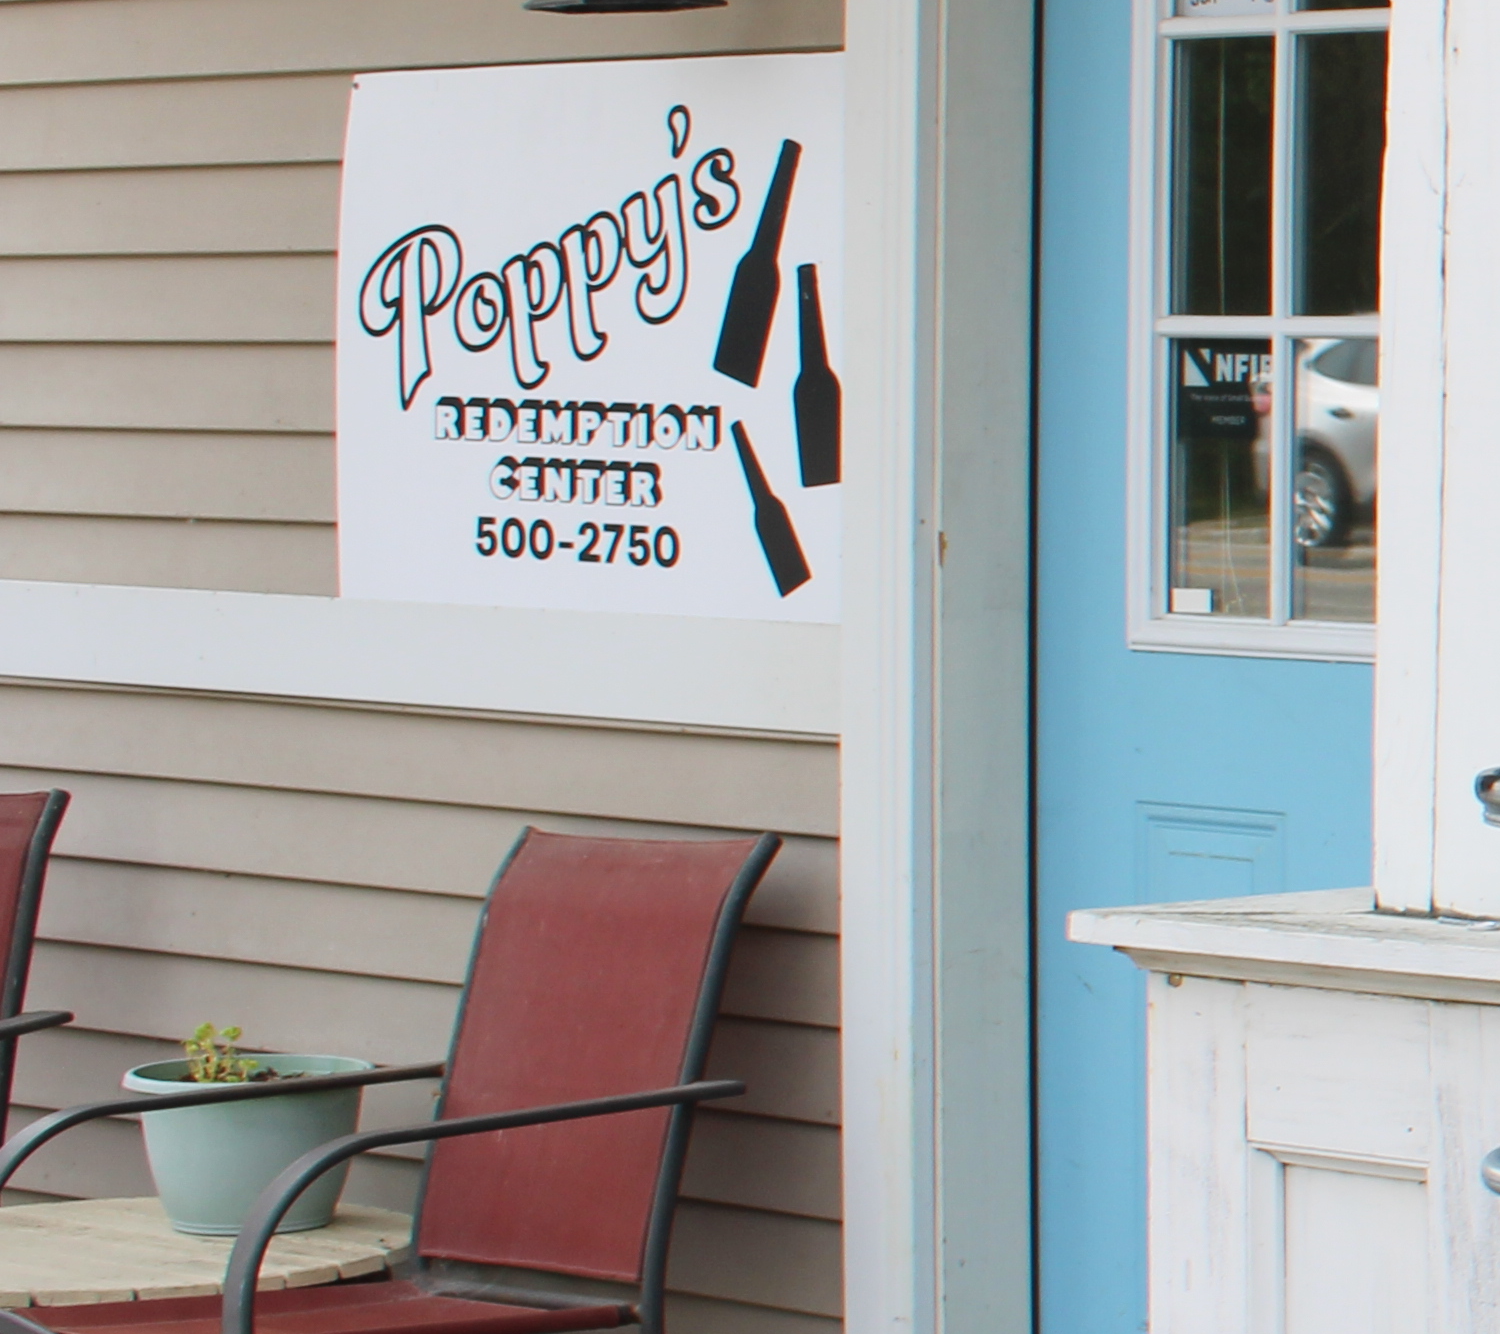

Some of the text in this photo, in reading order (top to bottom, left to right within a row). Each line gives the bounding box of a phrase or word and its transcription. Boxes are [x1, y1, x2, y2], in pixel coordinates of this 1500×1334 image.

[359, 104, 741, 410] Poppy's
[434, 397, 721, 450] REDEMPTION
[490, 456, 662, 507] CENTER
[475, 517, 680, 568] 500-2750
